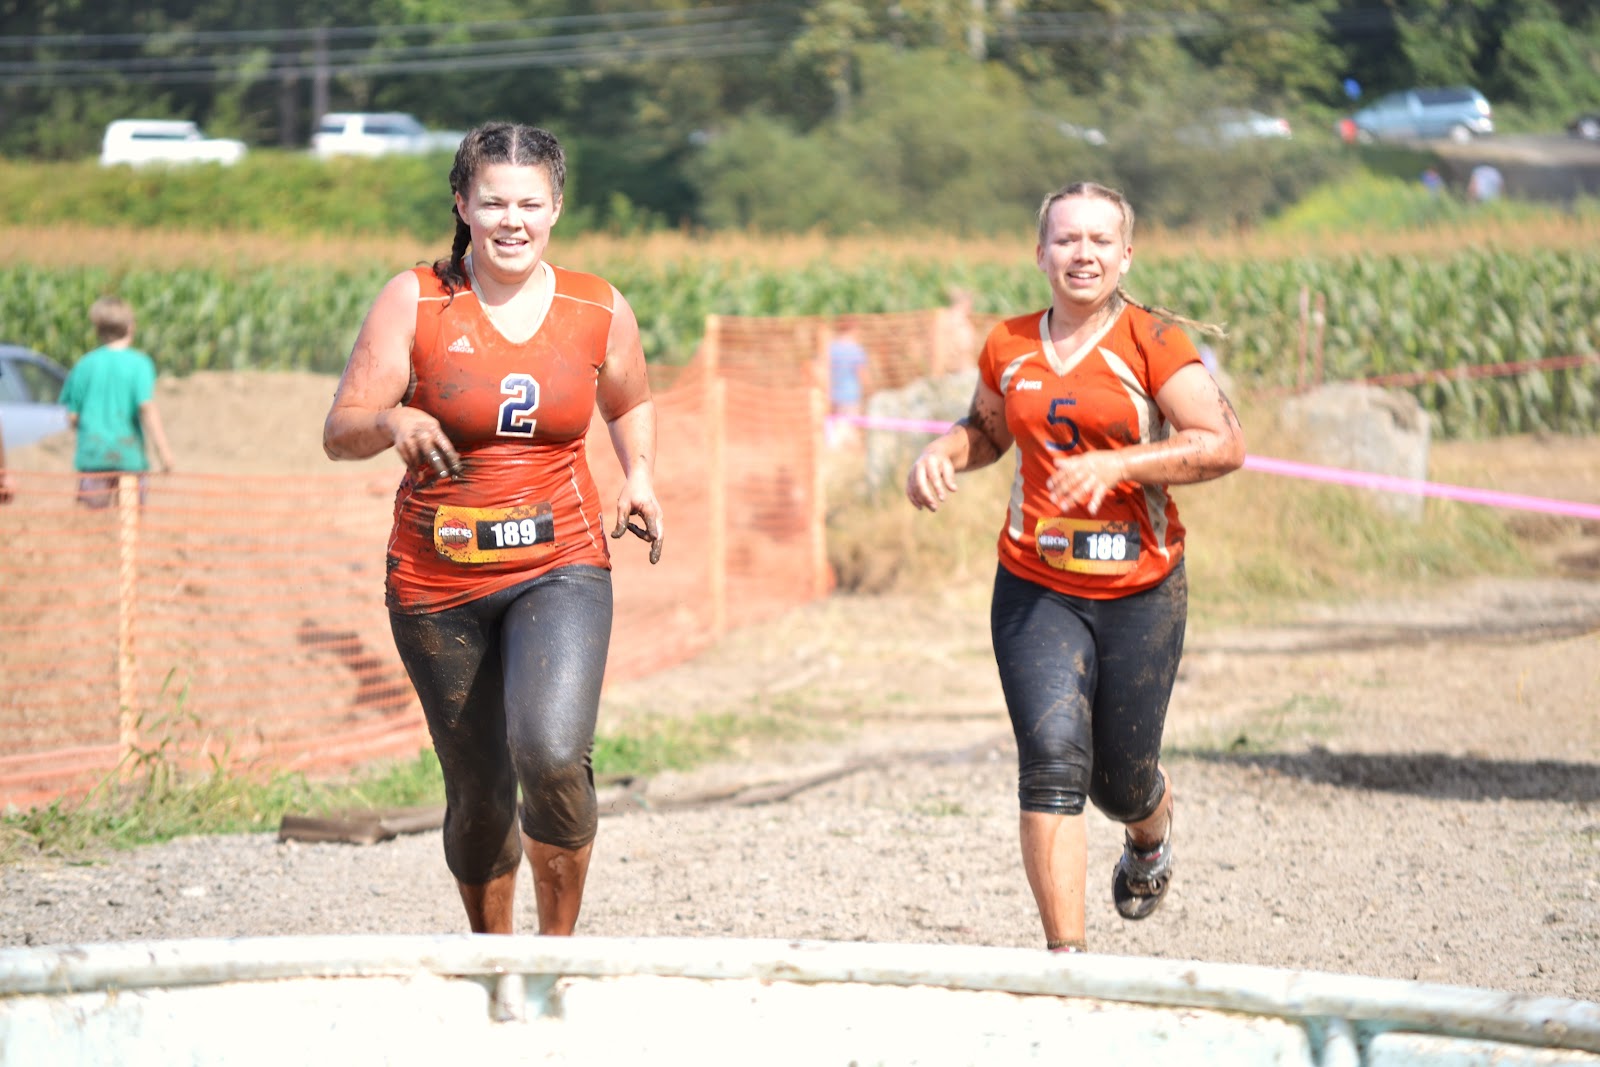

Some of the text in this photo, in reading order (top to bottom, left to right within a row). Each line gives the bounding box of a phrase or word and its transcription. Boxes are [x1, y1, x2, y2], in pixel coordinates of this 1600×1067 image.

[496, 372, 540, 438] 2
[1045, 398, 1079, 451] 5
[438, 527, 472, 538] HEROES
[491, 519, 537, 547] 189
[1087, 533, 1126, 560] 188
